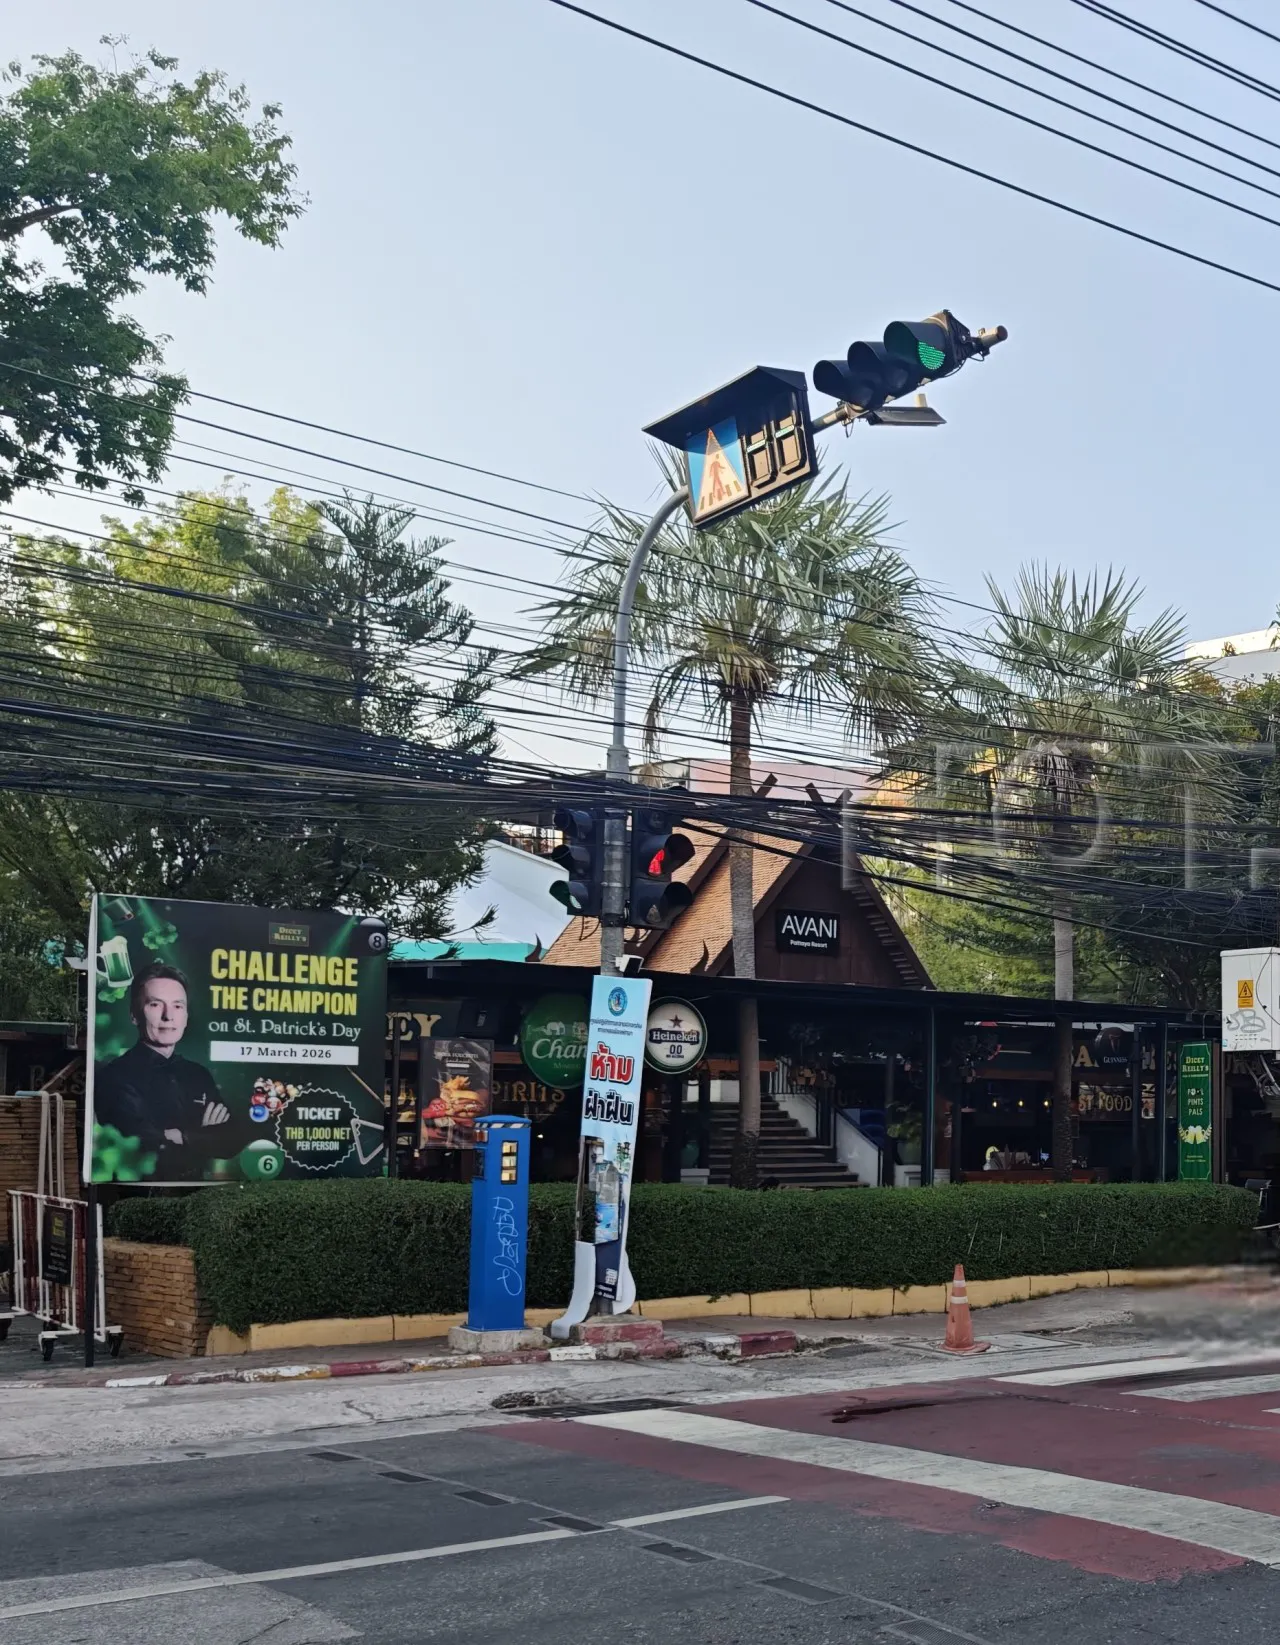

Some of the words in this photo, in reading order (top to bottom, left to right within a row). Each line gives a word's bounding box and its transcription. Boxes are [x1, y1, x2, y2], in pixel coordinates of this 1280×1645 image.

[781, 914, 837, 938] AVANI
[373, 935, 382, 949] 8
[790, 939, 811, 948] Pattaya
[811, 941, 828, 949] Resort
[211, 948, 358, 987] CHALLENGE
[210, 985, 248, 1011] THE
[252, 988, 357, 1016] CHAMPION
[208, 1021, 229, 1033] on
[234, 1018, 256, 1034] St.
[261, 1019, 327, 1037] Patrick's
[332, 1023, 361, 1042] Day
[652, 1030, 698, 1042] Heineken
[240, 1046, 252, 1056] 17
[257, 1046, 297, 1058] March
[302, 1048, 332, 1059] 2026
[531, 1038, 589, 1060] Chan
[590, 1041, 634, 1084] ห้าม
[584, 1087, 634, 1125] ฝ่าฝืน
[1078, 1093, 1094, 1112] ST
[1098, 1092, 1133, 1112] FOOD
[1188, 1098, 1204, 1106] PINTS
[296, 1107, 341, 1120] TICKET
[1188, 1108, 1203, 1116] PALS
[285, 1127, 304, 1140] THB
[306, 1127, 331, 1141] 1,000
[333, 1127, 351, 1140] NET
[296, 1141, 310, 1150] PER
[312, 1141, 340, 1151] PERSON
[263, 1157, 273, 1171] 6
